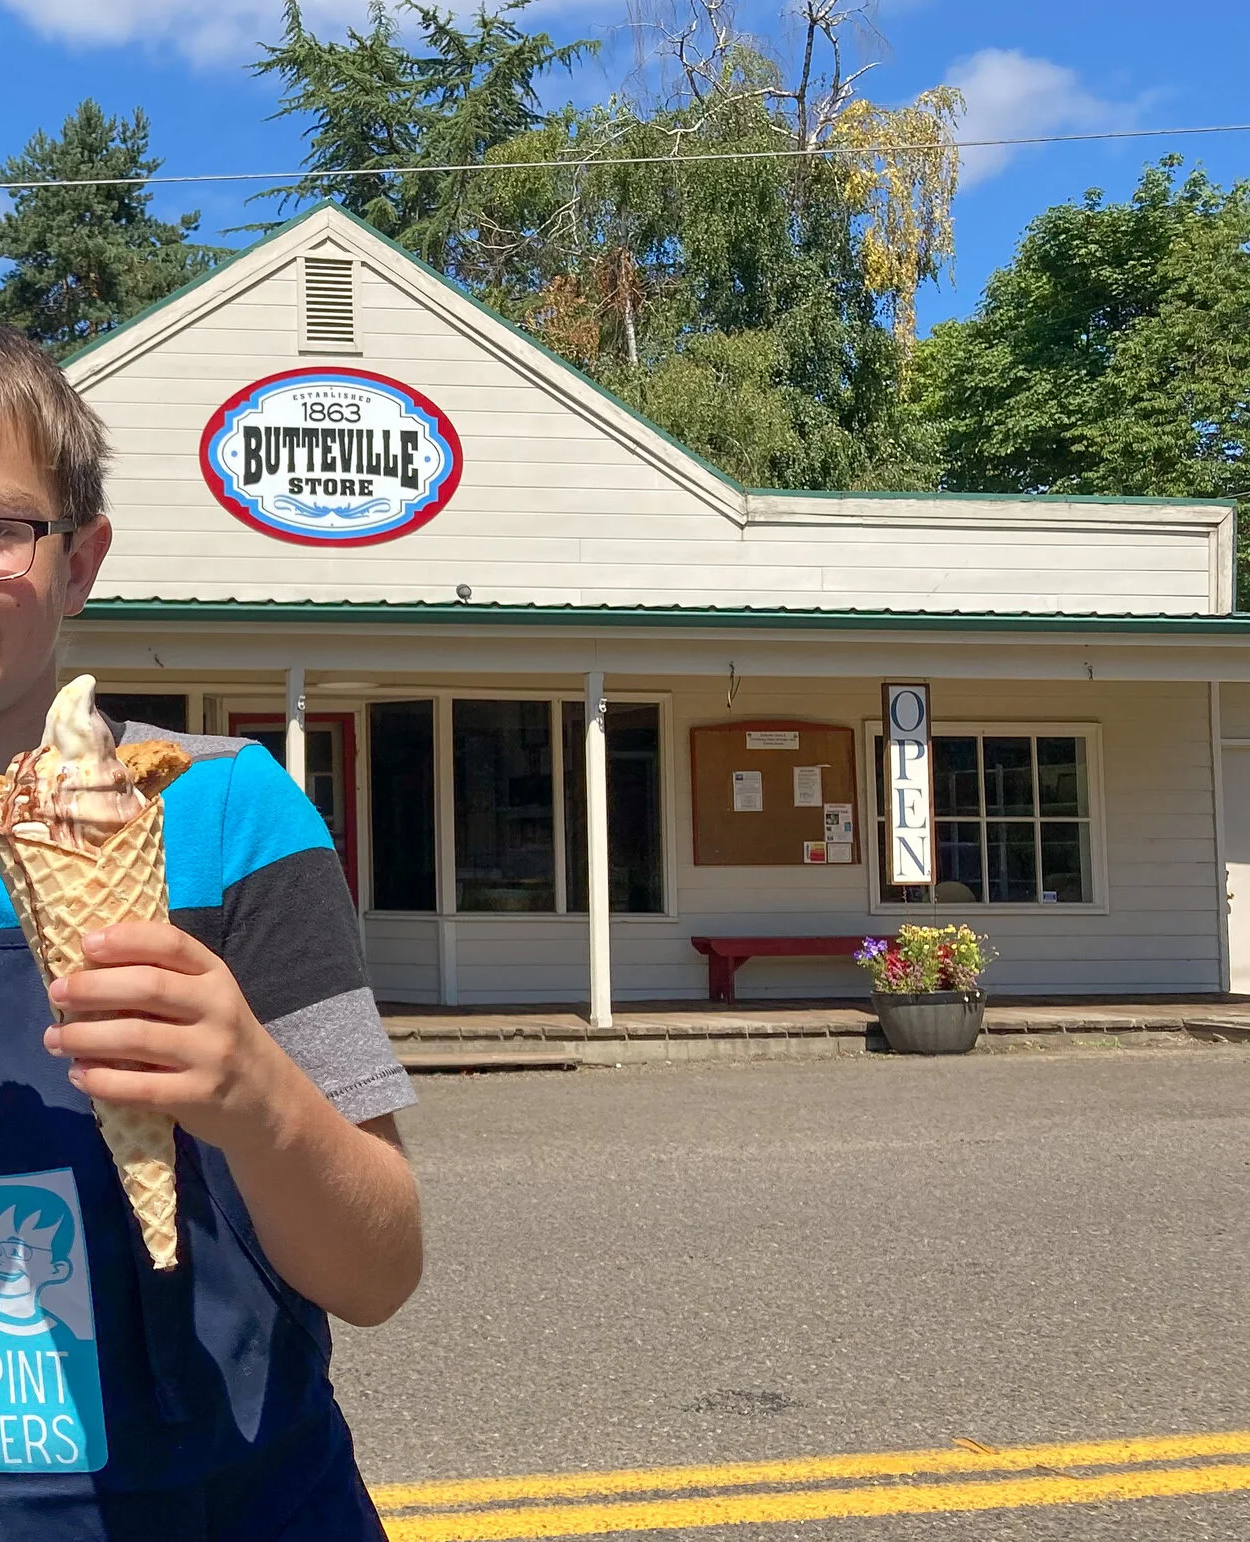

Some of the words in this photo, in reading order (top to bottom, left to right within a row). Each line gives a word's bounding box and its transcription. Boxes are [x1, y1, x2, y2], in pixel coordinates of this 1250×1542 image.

[293, 392, 371, 403] ESTABLISHED
[302, 402, 361, 423] 1863
[243, 425, 419, 490] BUTTEVILLE
[288, 477, 373, 496] STORE
[890, 690, 927, 877] OPEN
